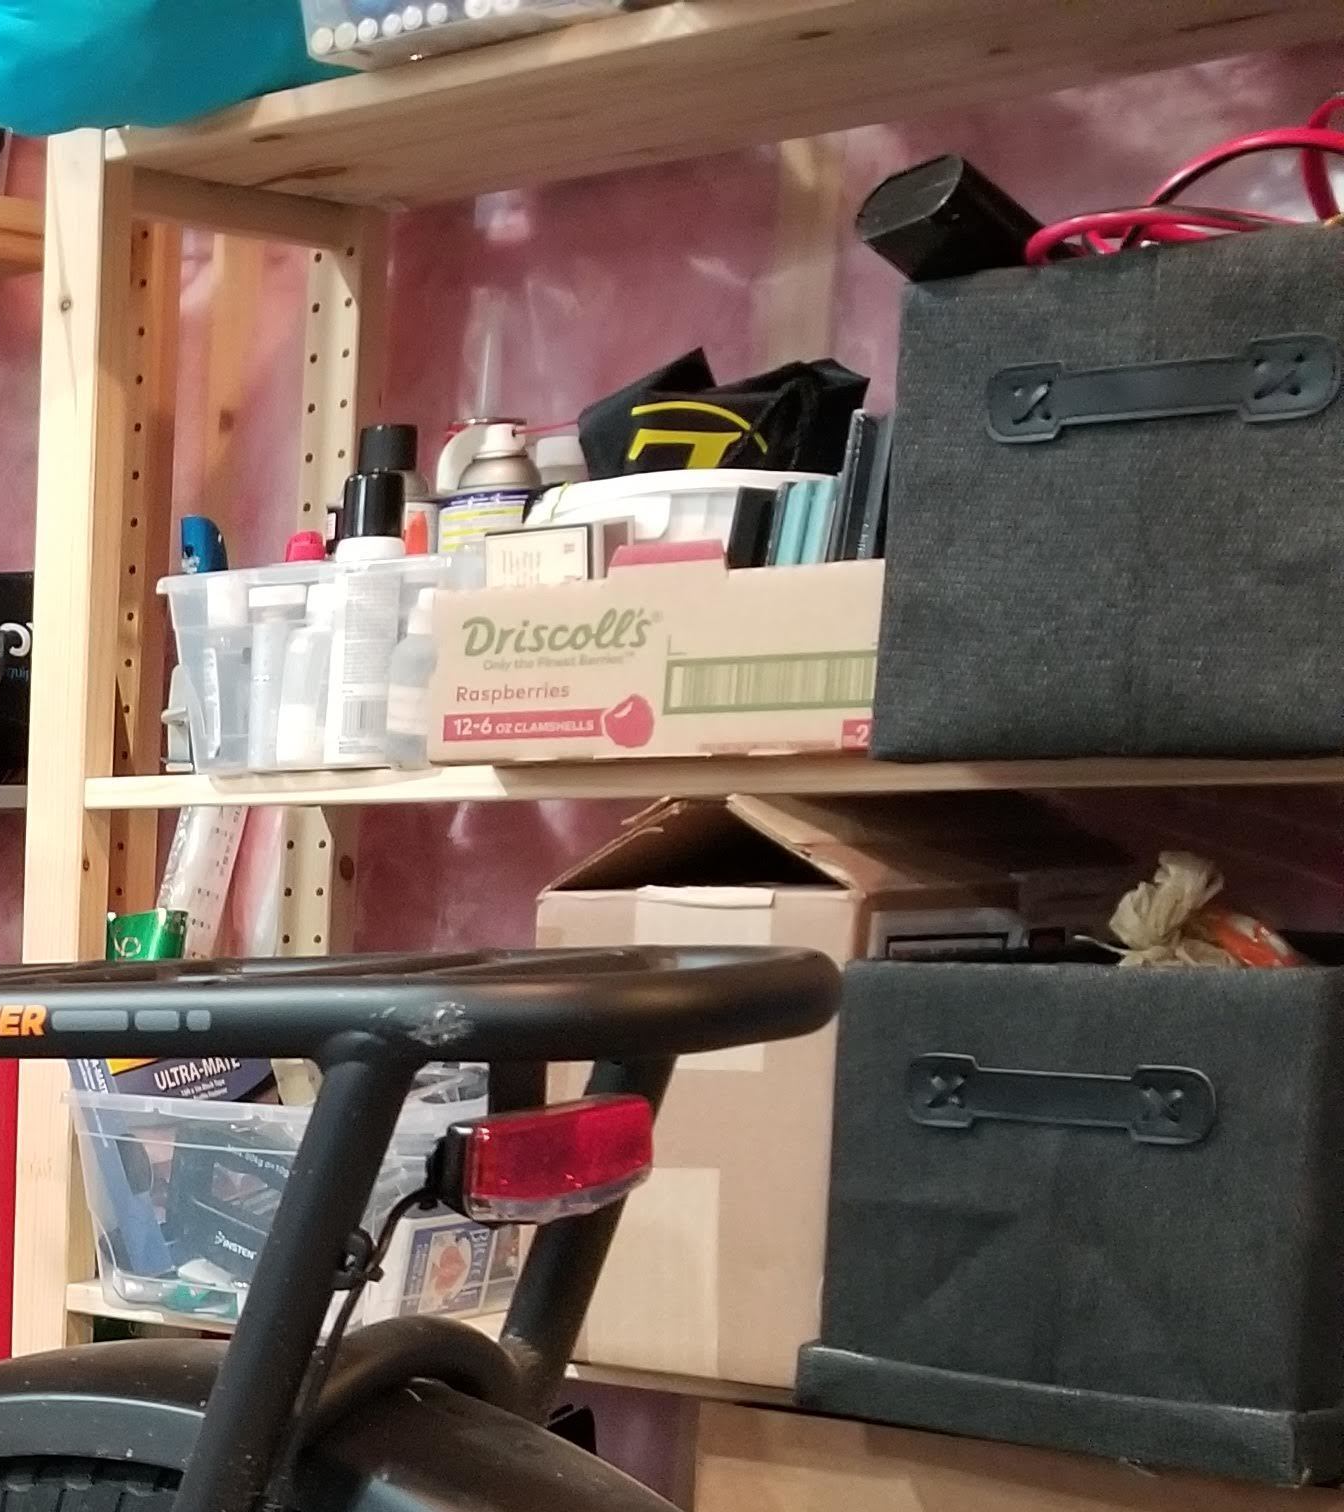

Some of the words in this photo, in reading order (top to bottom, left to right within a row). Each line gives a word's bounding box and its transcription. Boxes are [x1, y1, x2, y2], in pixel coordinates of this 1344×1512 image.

[462, 607, 653, 657] Driscoll's
[456, 681, 570, 704] Raspberries
[453, 718, 492, 736] 12-6
